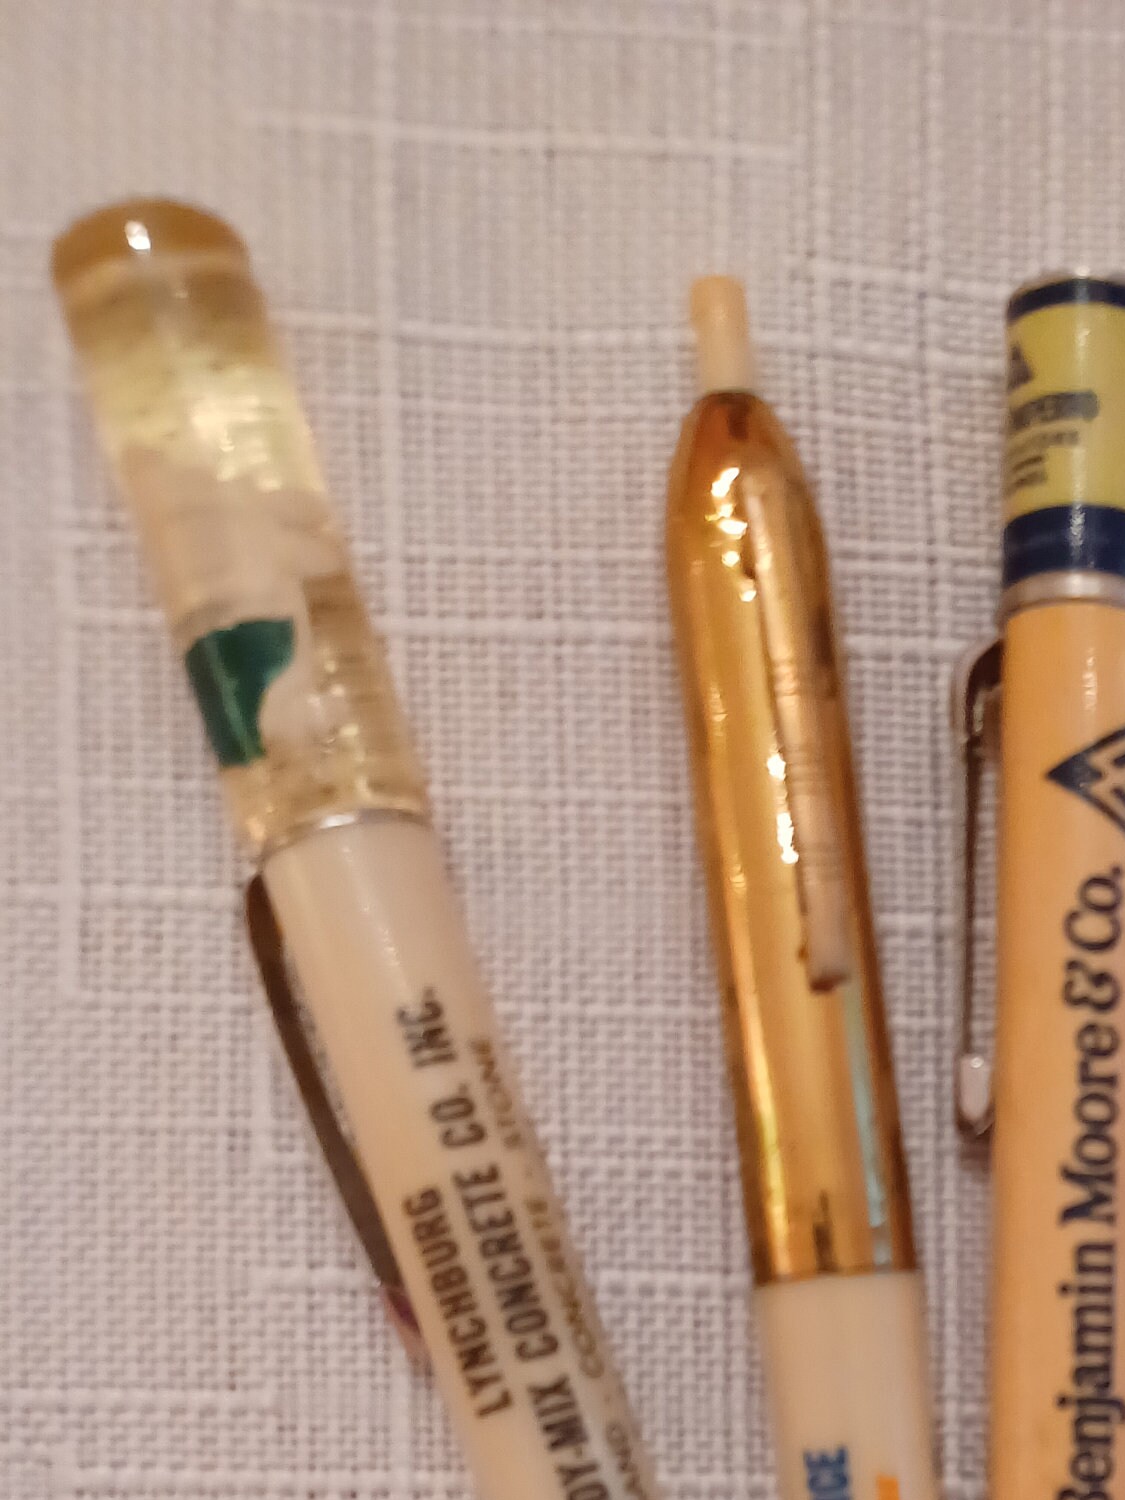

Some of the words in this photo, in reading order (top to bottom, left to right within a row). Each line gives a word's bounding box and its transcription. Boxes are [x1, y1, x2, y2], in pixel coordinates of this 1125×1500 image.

[1063, 866, 1123, 951] Co.
[396, 987, 457, 1069] INC.
[429, 1083, 487, 1151] CO.
[1060, 1021, 1120, 1228] Moore
[403, 1186, 513, 1418] LYNCHBURG
[452, 1163, 559, 1364] CONCRETE
[523, 1195, 603, 1380] CONCRETE
